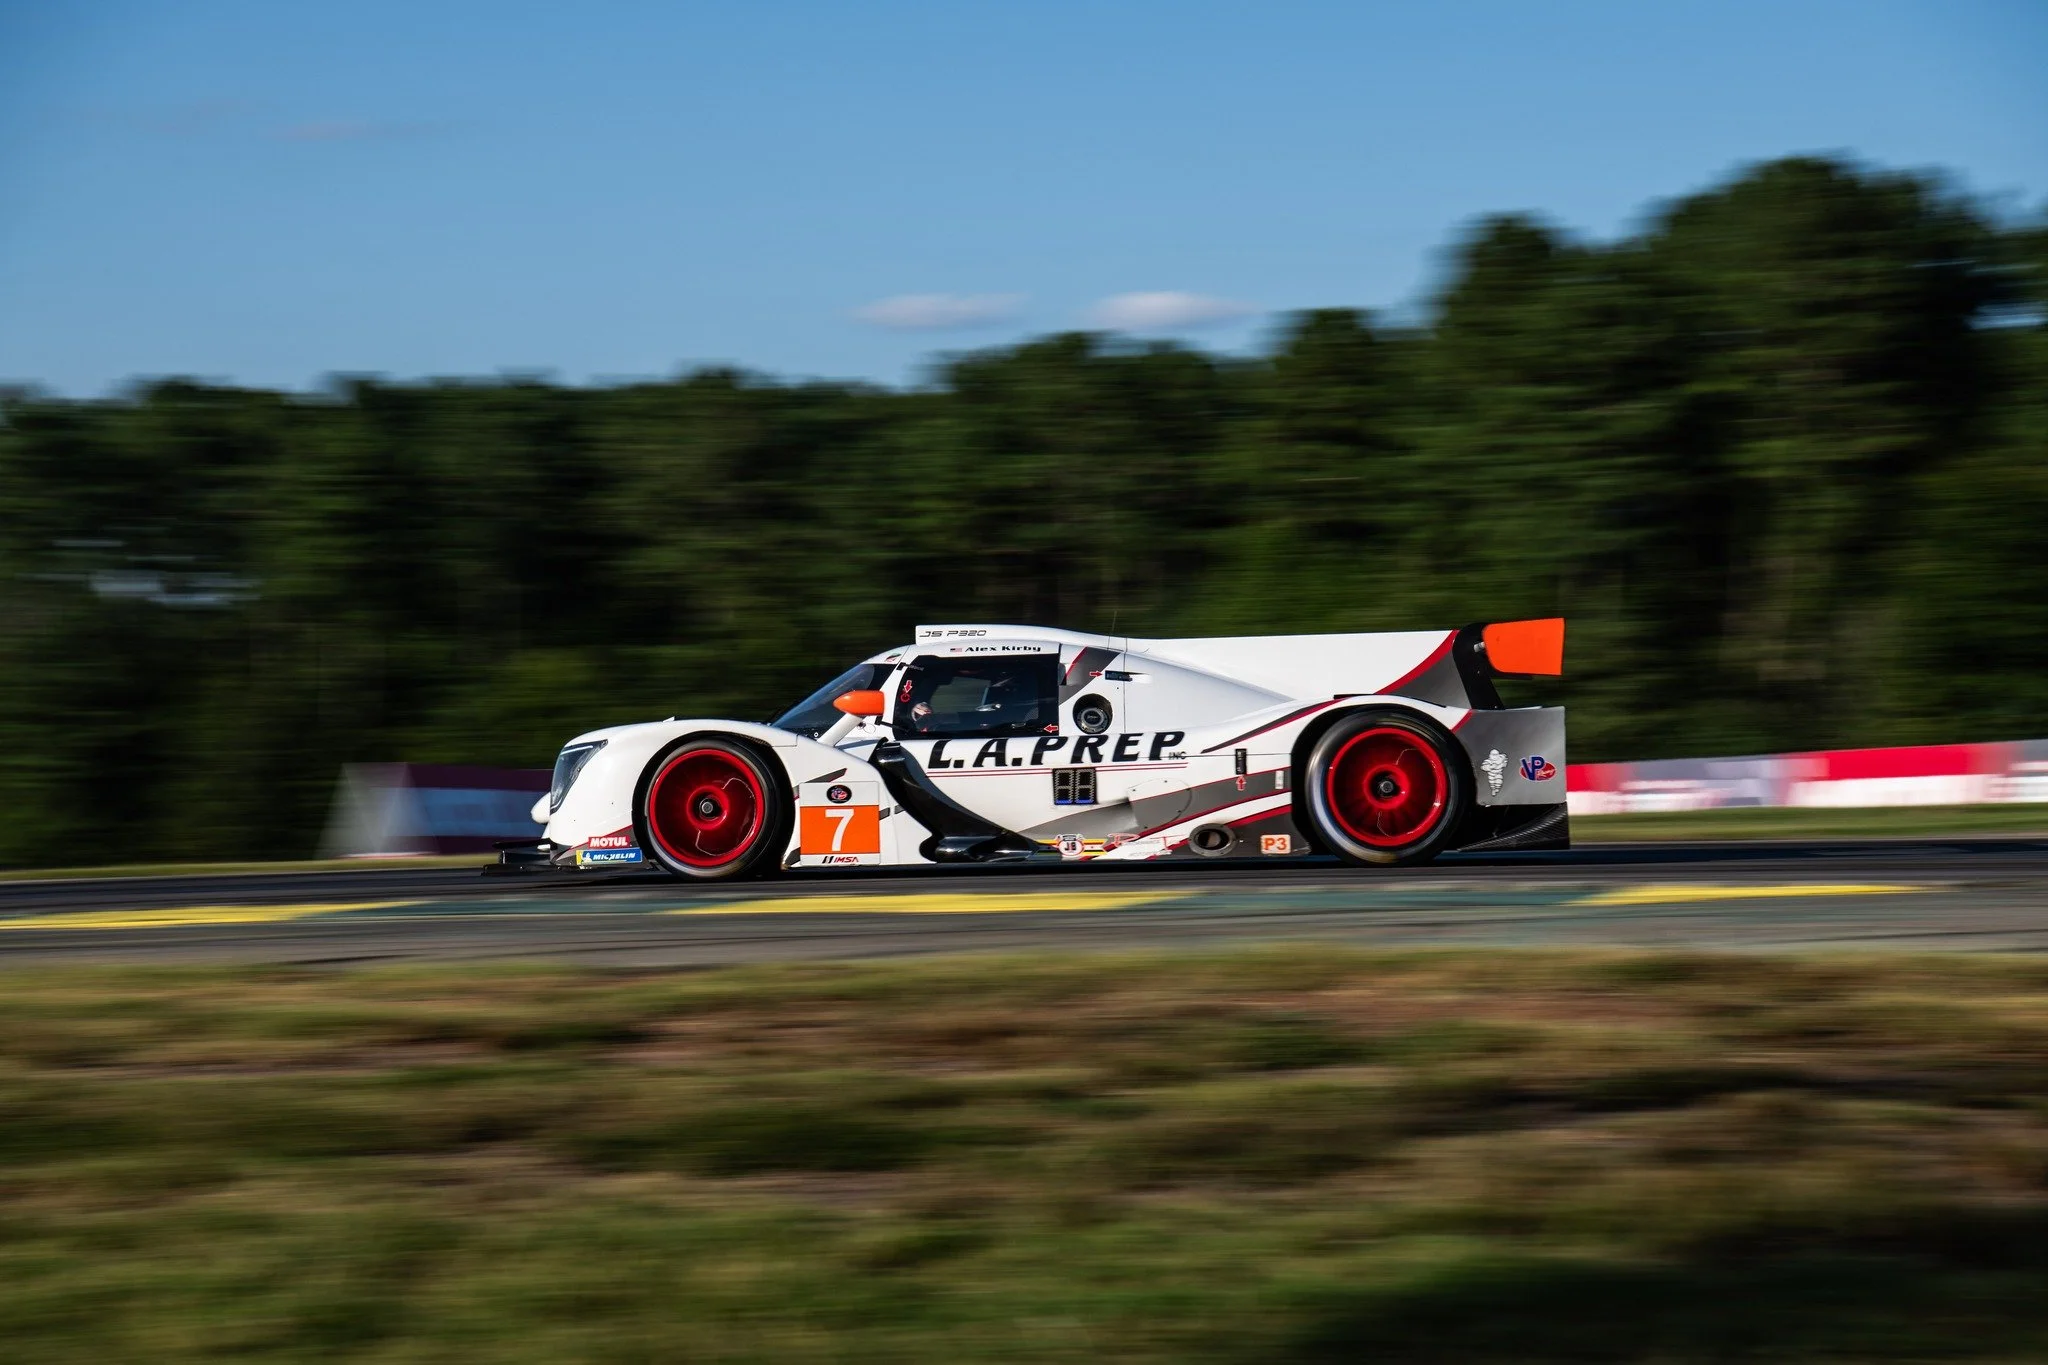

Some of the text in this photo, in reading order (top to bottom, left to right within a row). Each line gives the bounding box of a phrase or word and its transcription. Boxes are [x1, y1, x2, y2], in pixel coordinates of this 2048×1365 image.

[919, 629, 987, 638] JS P320
[1001, 645, 1041, 653] Kirby
[1520, 756, 1545, 781] VP
[825, 808, 854, 852] 7
[589, 836, 628, 848] MOTUL
[1264, 838, 1287, 850] P3
